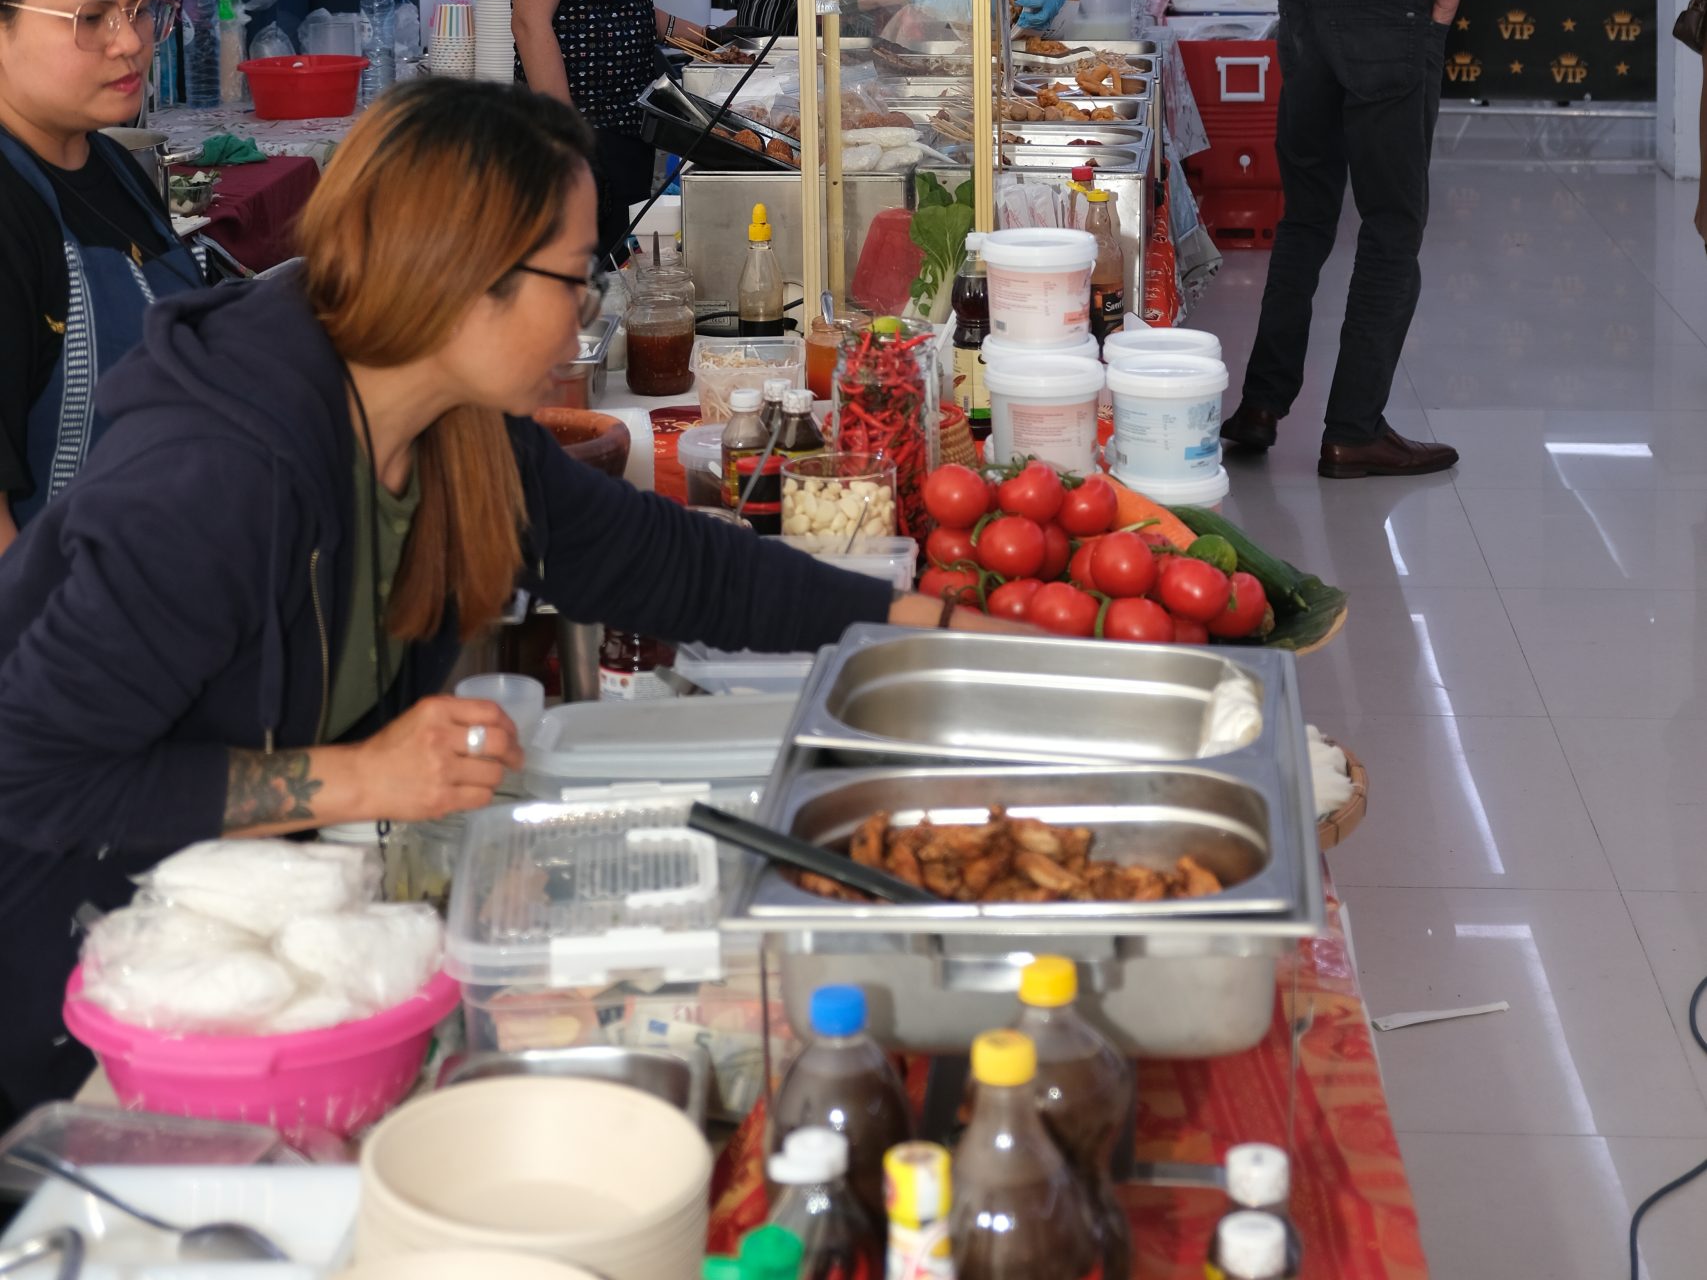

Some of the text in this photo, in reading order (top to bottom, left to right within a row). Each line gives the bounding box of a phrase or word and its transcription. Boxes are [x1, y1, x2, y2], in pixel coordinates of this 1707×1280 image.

[1500, 24, 1535, 40] VIP
[1606, 24, 1641, 41] VIP
[1446, 66, 1482, 82] VIP
[1552, 66, 1587, 83] VIP
